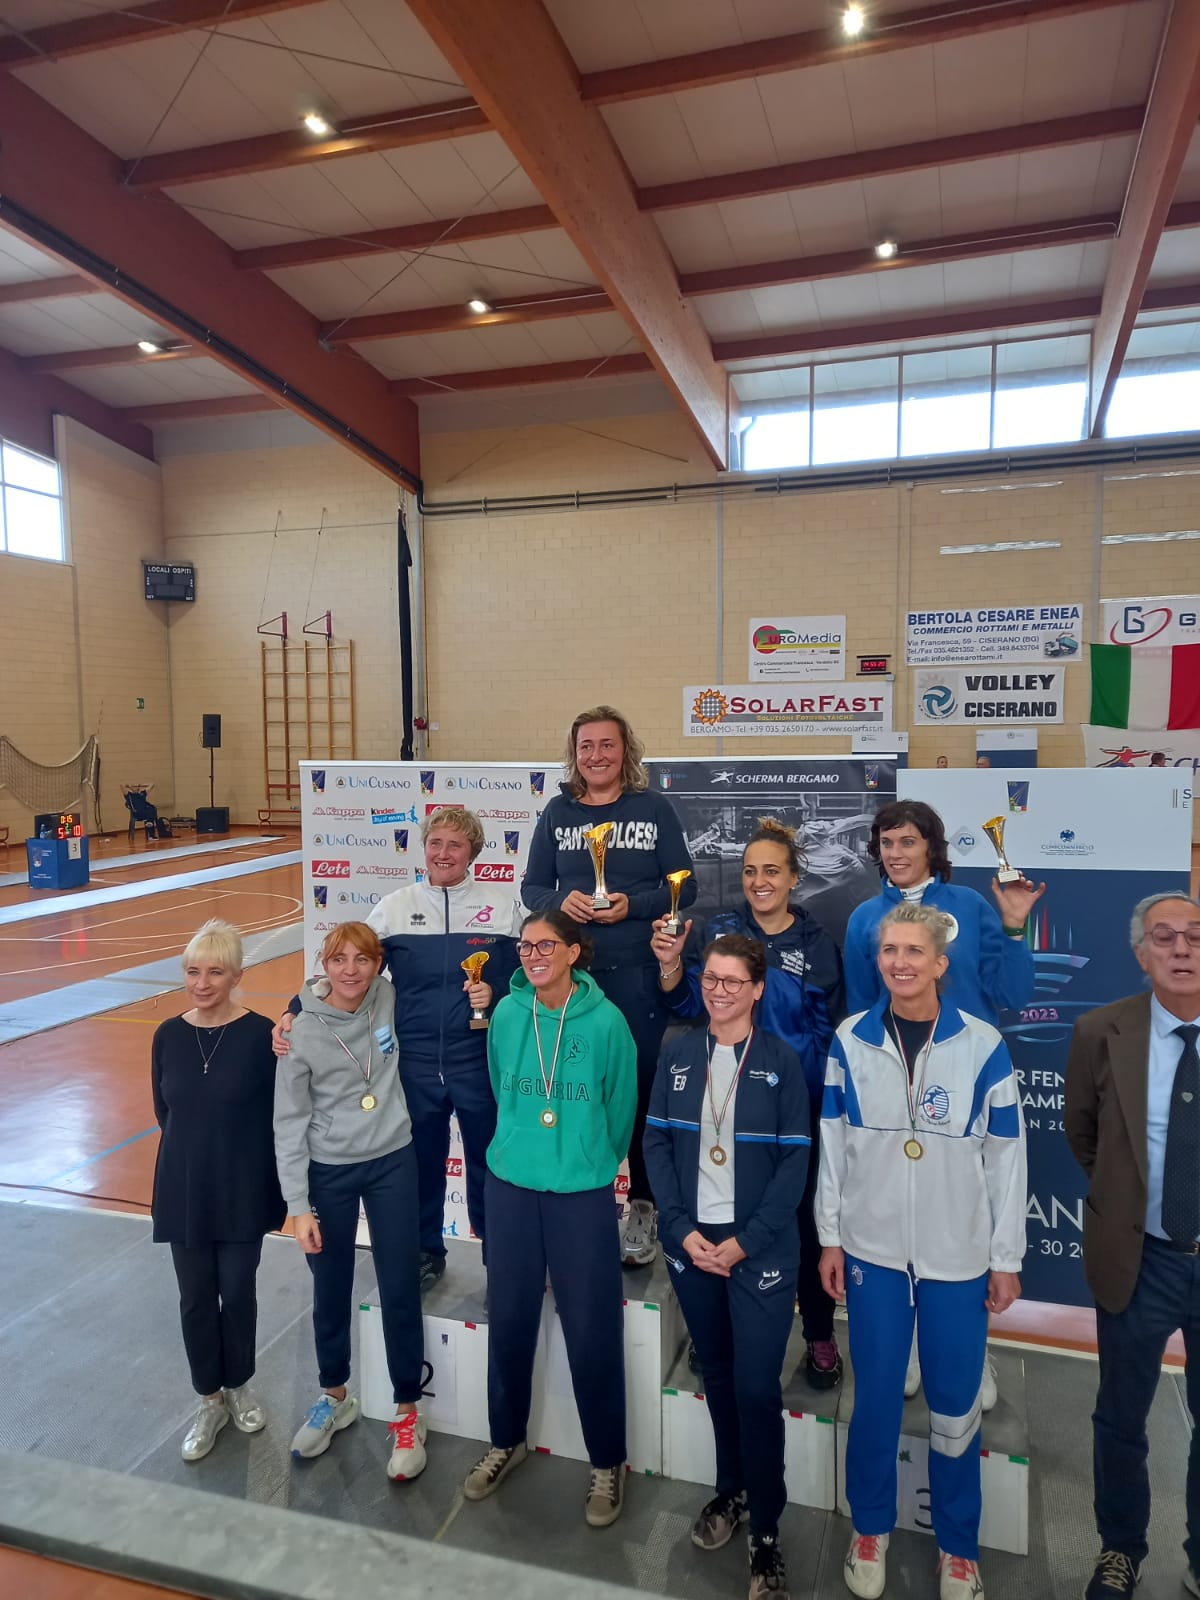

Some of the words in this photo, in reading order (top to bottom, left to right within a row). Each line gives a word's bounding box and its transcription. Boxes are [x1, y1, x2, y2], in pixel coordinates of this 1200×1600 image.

[908, 612, 972, 625] BERTOLA
[977, 609, 1035, 623] CESARE
[1040, 606, 1080, 620] ENEA
[913, 626, 972, 635] COMMERCIO
[976, 624, 1019, 633] ROTTAMI
[1032, 622, 1074, 631] METALLI
[1022, 636, 1039, 644] (BG)
[964, 674, 1055, 691] VOLLEY
[964, 702, 1057, 718] CISERANO
[822, 724, 884, 733] www.solarfast.it
[735, 774, 784, 784] SCHERMA
[786, 774, 839, 784] BERGAMO
[326, 807, 365, 817] Kappa
[490, 809, 529, 819] Kappa
[314, 862, 350, 876] Lete
[370, 866, 407, 876] Kappa
[477, 864, 514, 879] Lete
[1020, 1008, 1058, 1021] 2023
[673, 1075, 687, 1091] EB
[1026, 1193, 1083, 1232] AN
[1041, 1239, 1063, 1256] 30
